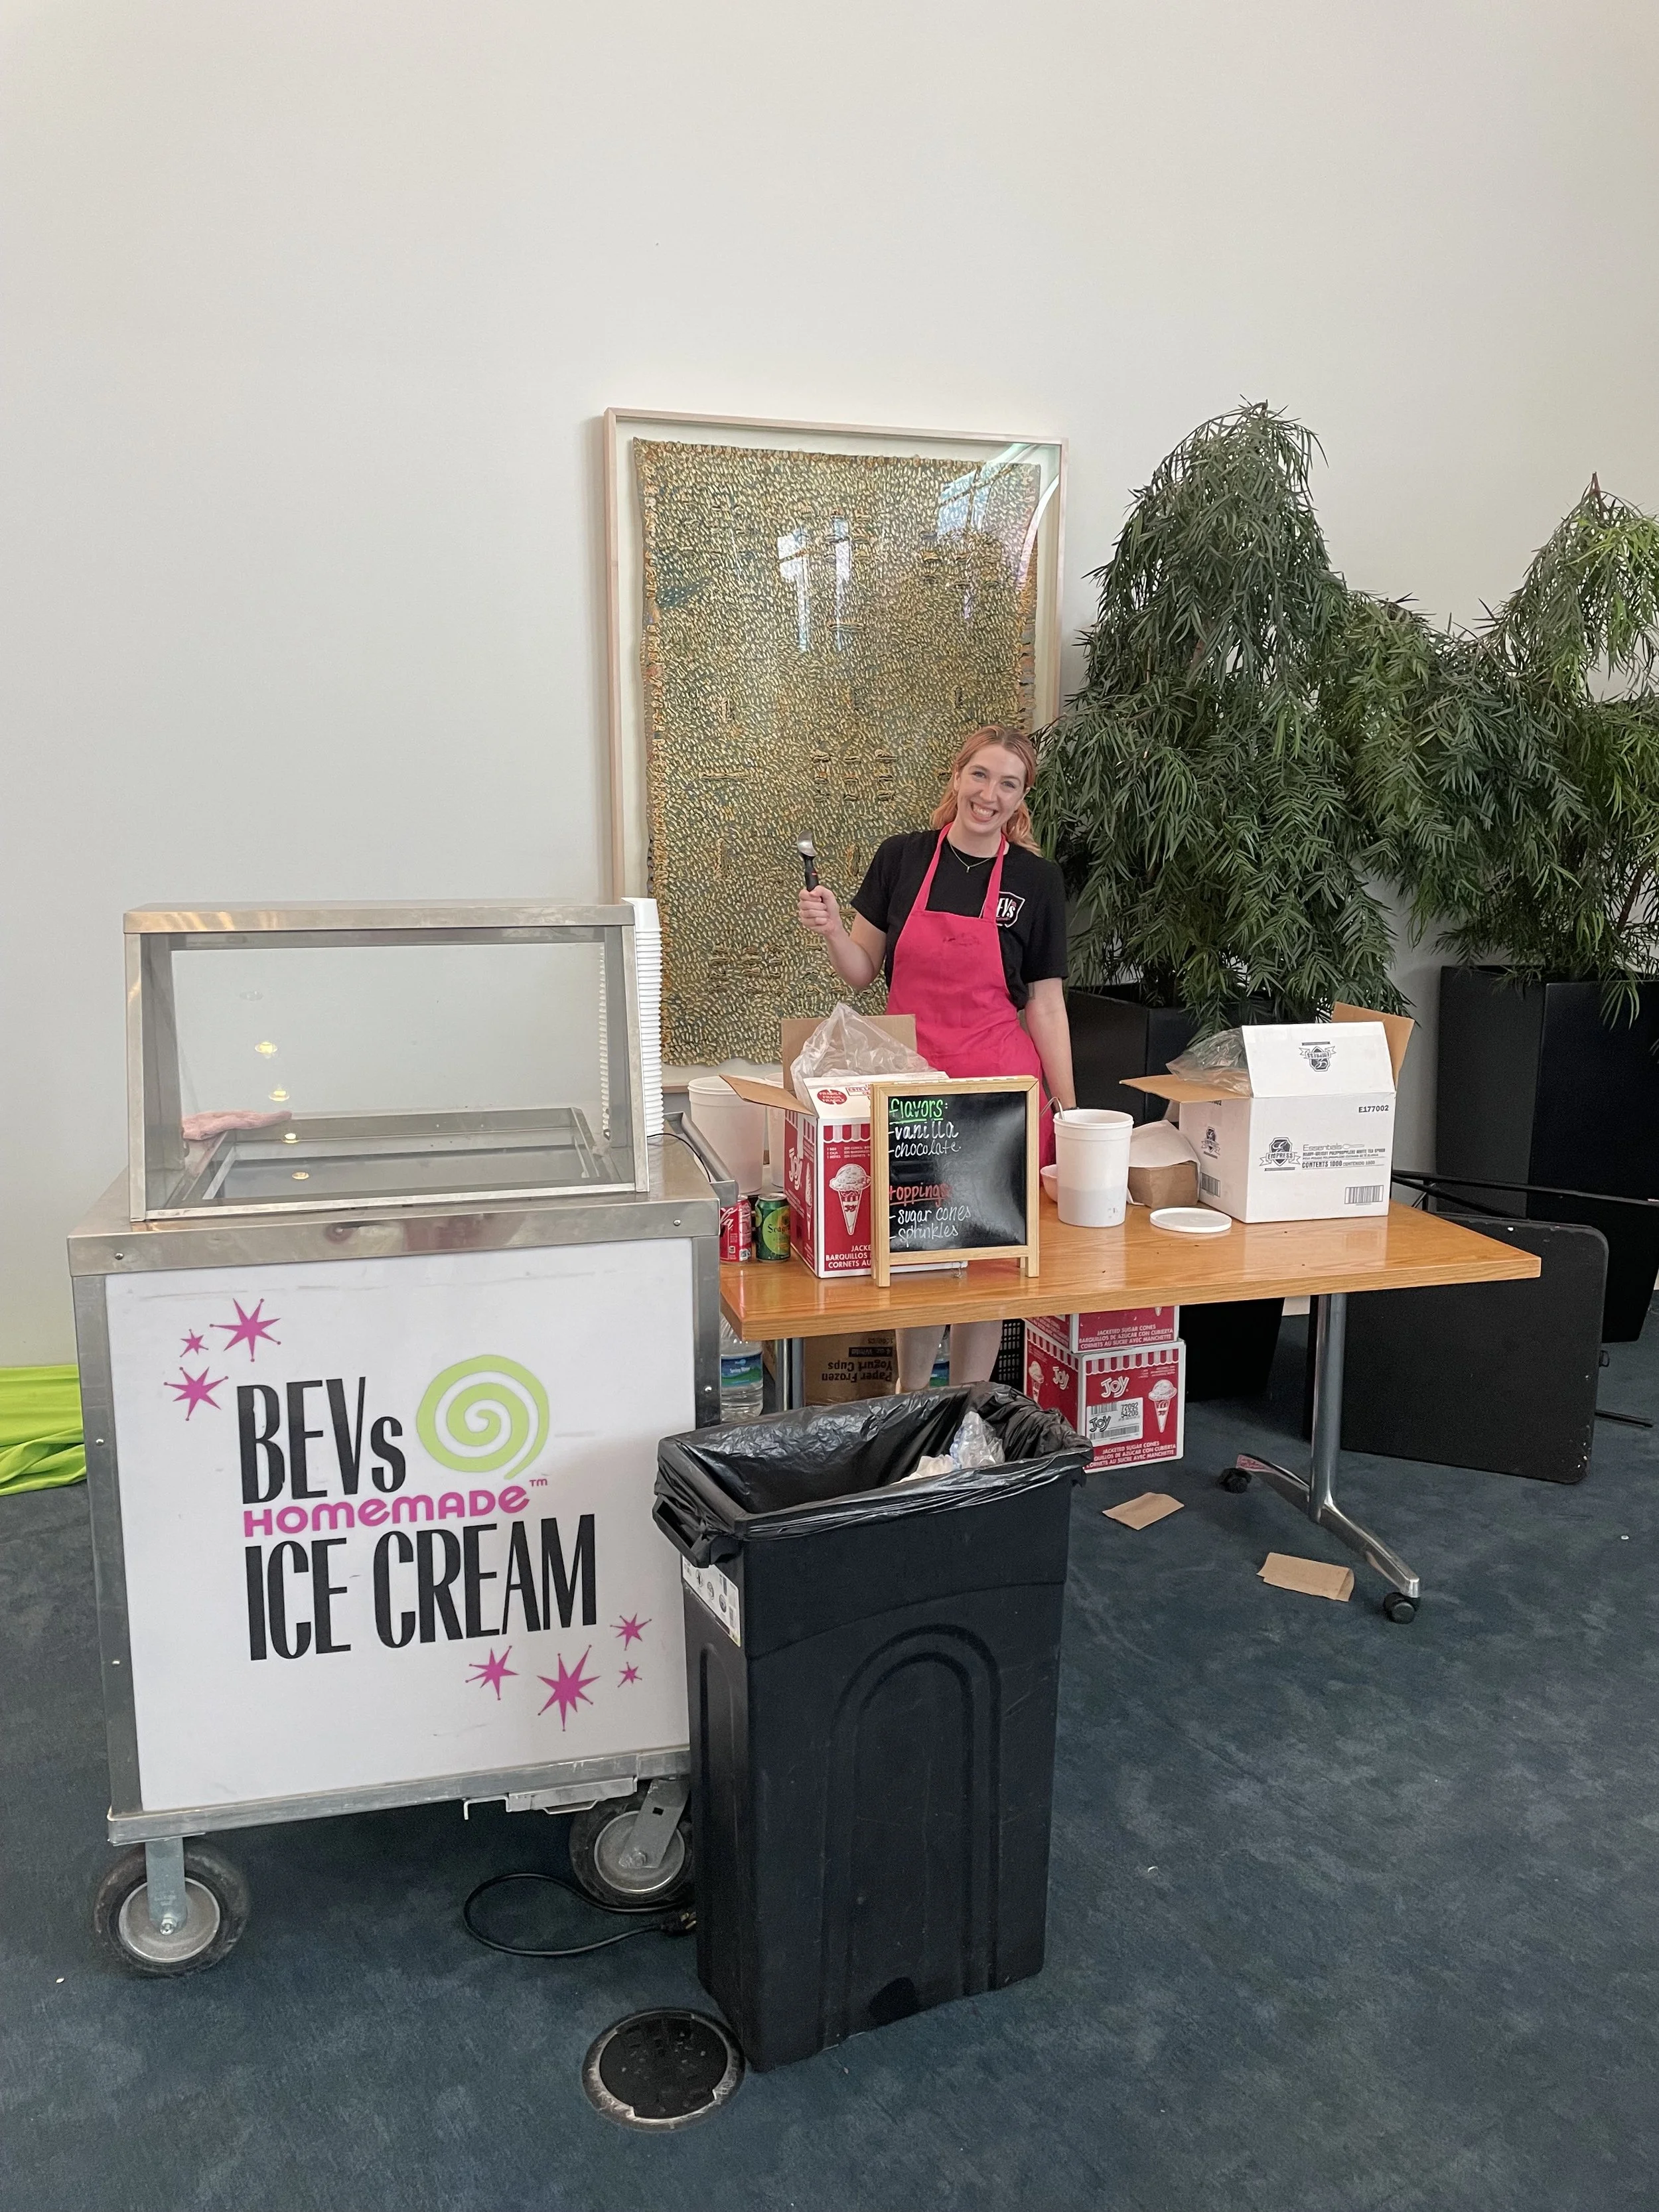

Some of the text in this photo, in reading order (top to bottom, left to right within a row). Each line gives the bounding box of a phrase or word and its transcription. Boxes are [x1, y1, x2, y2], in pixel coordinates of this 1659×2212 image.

[995, 897, 1015, 918] EVs
[1303, 1143, 1342, 1151] Essentials
[936, 1205, 971, 1221] cones
[826, 1252, 868, 1262] BARQUILLOS
[1079, 1335, 1109, 1343] BARQUILLOS
[828, 1359, 893, 1372] Yogurt Cups
[822, 1370, 893, 1383] Paper Frozen
[1147, 1449, 1174, 1458] MANCHETTE
[244, 1514, 597, 1661] ICE CREAM
